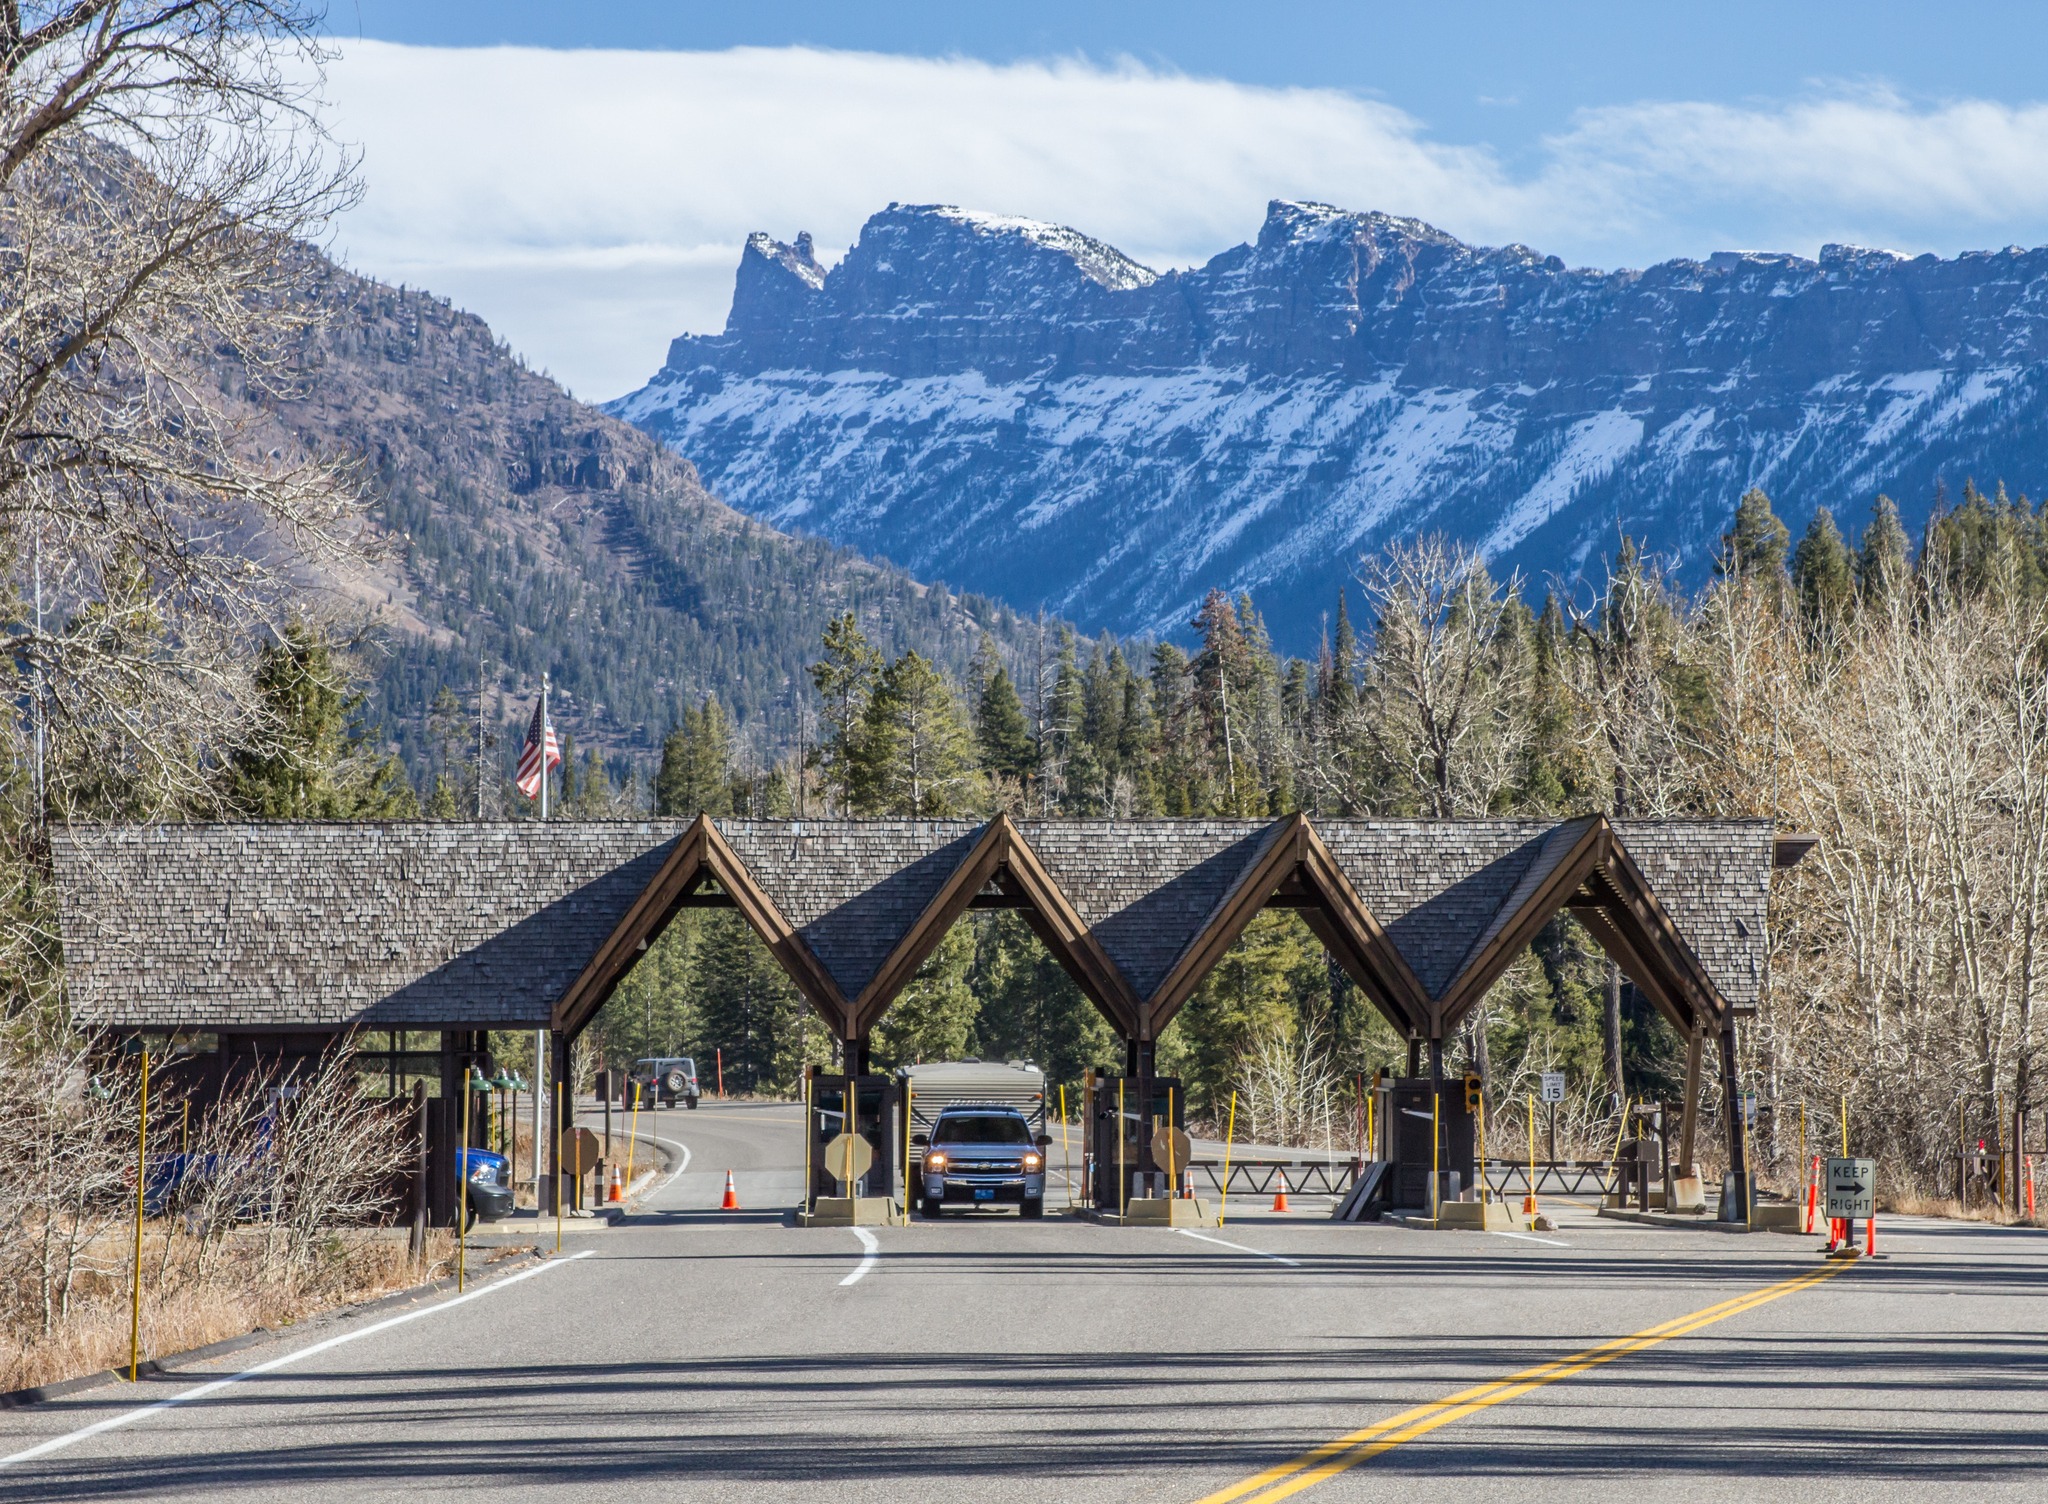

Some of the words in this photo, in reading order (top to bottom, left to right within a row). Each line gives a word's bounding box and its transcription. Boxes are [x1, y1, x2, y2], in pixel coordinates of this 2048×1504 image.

[1547, 1088, 1561, 1099] 15
[1833, 1167, 1869, 1178] KEEP
[1830, 1199, 1870, 1210] RIGHT
